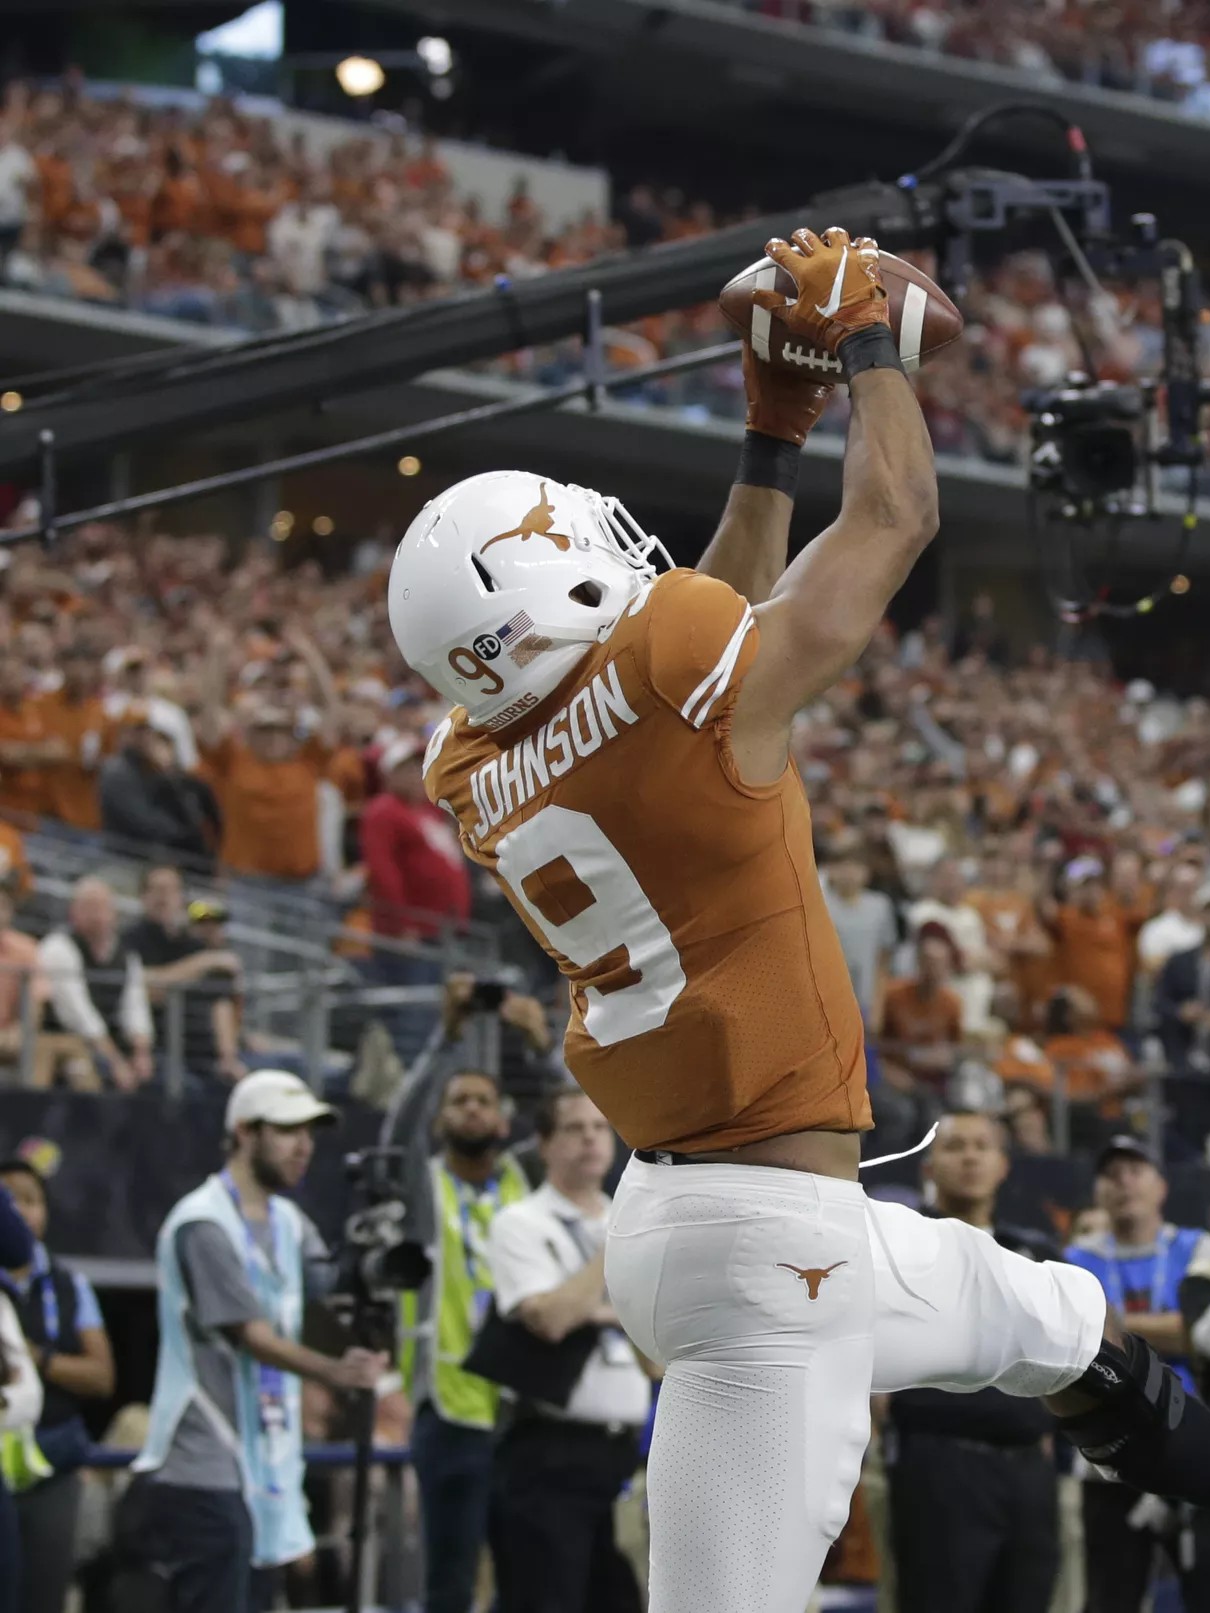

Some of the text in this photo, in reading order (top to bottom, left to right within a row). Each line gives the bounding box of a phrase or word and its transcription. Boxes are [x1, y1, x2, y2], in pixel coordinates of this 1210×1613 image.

[448, 647, 504, 695] 9
[474, 636, 500, 659] FD
[470, 660, 639, 838] JOHNSON
[496, 804, 686, 1046] 9
